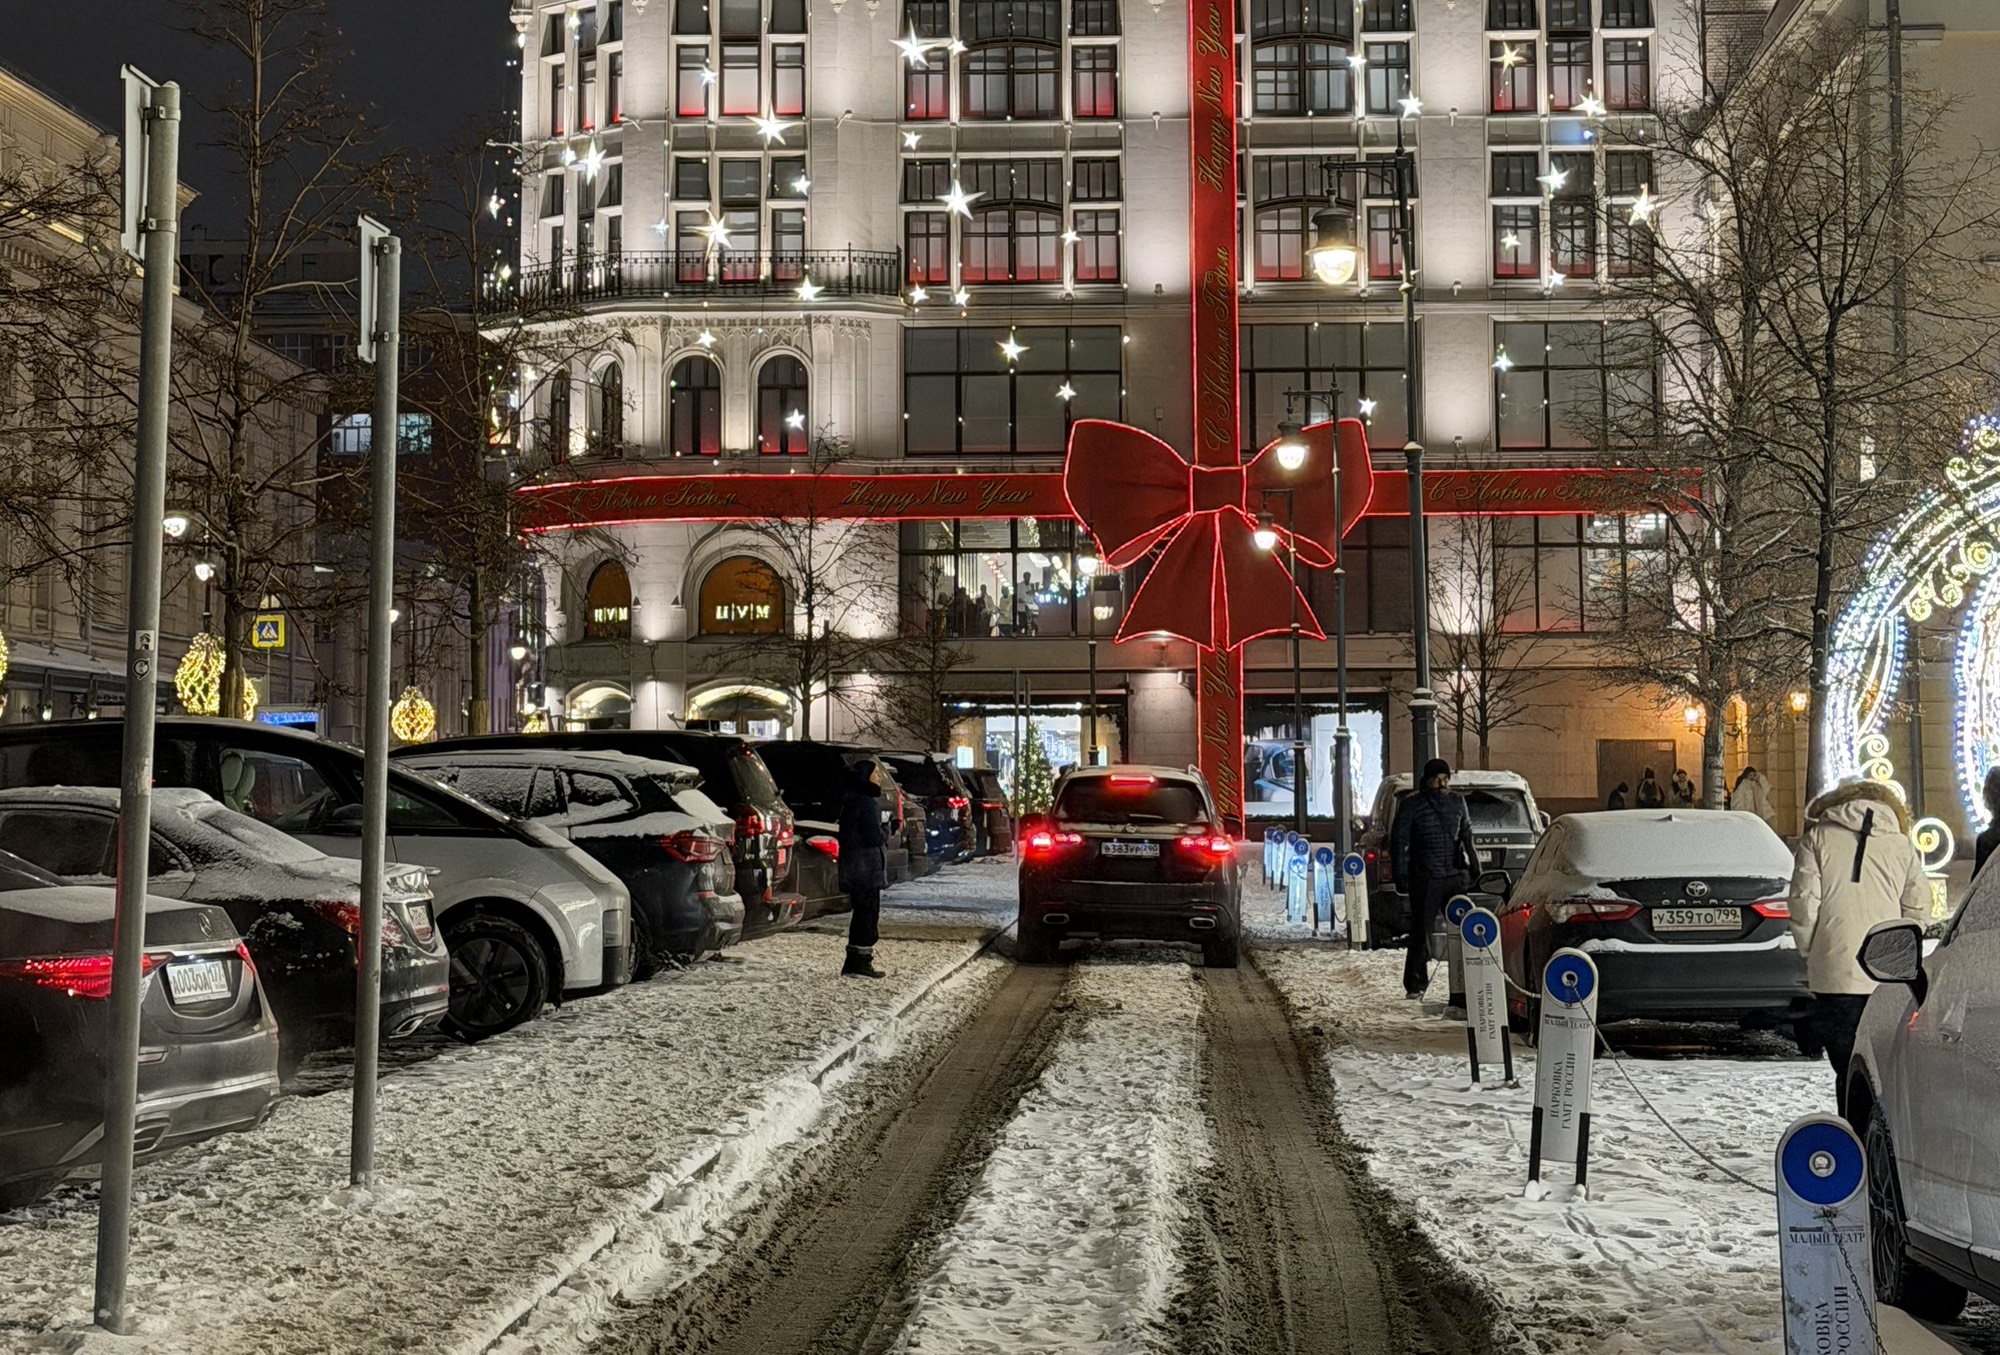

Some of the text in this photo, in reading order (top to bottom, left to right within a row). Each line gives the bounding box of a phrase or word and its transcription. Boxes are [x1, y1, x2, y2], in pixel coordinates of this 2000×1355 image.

[1196, 3, 1231, 192] Happy New Year
[1202, 245, 1231, 450] С Новым Годом
[589, 485, 657, 512] Новым
[662, 482, 738, 507] Годом
[842, 478, 1035, 514] Happy New Year
[1422, 474, 1453, 502] С
[1453, 473, 1548, 502] Новым
[1203, 641, 1239, 820] appy New Year
[1657, 909, 1738, 924] У359ТО 799
[1550, 1060, 1563, 1118] ПАРКОВКА
[1561, 1052, 1576, 1130] ГАМТ РОССИИ
[1789, 1231, 1830, 1244] МАЛЫЙ
